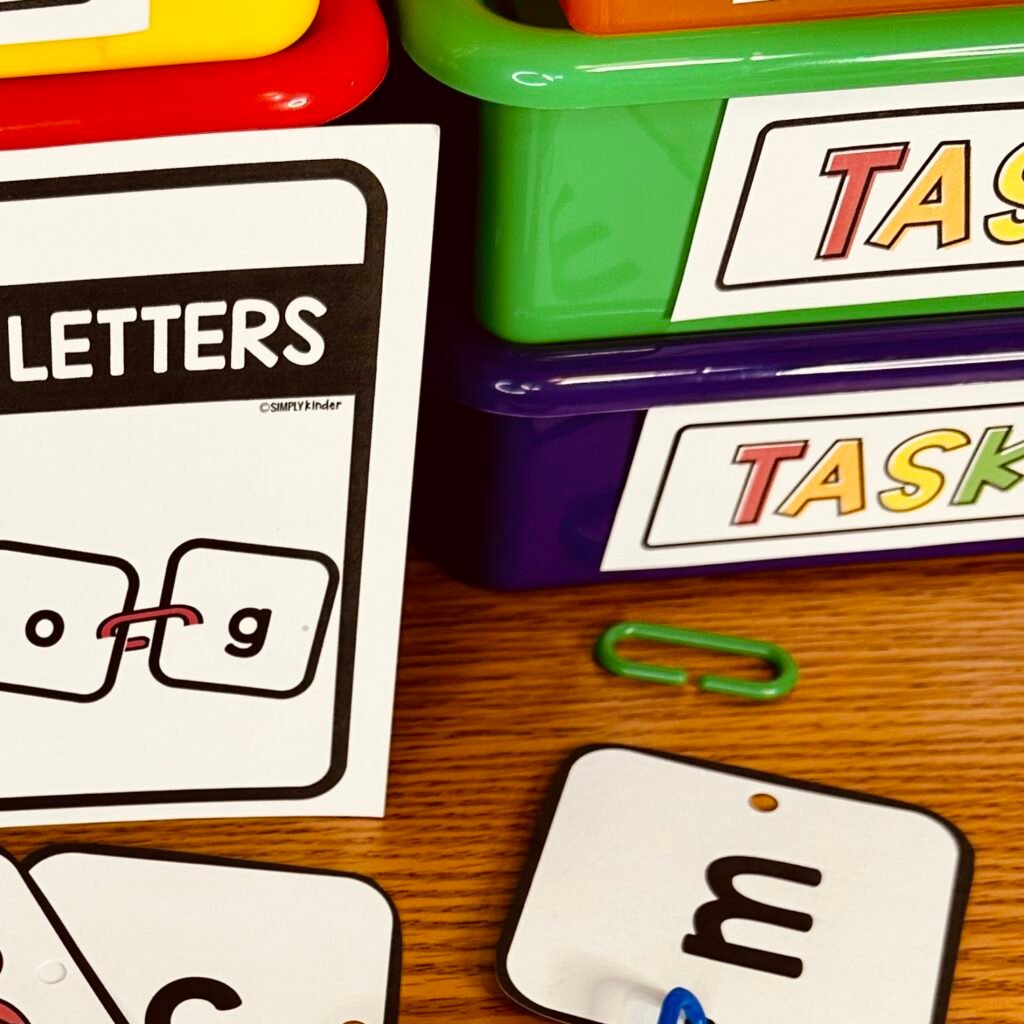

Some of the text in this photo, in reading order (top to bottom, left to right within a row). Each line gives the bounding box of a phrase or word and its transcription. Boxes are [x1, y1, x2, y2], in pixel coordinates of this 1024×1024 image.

[7, 296, 327, 382] LETTERS
[24, 609, 65, 648] o
[224, 607, 273, 659] g
[681, 855, 822, 979] m
